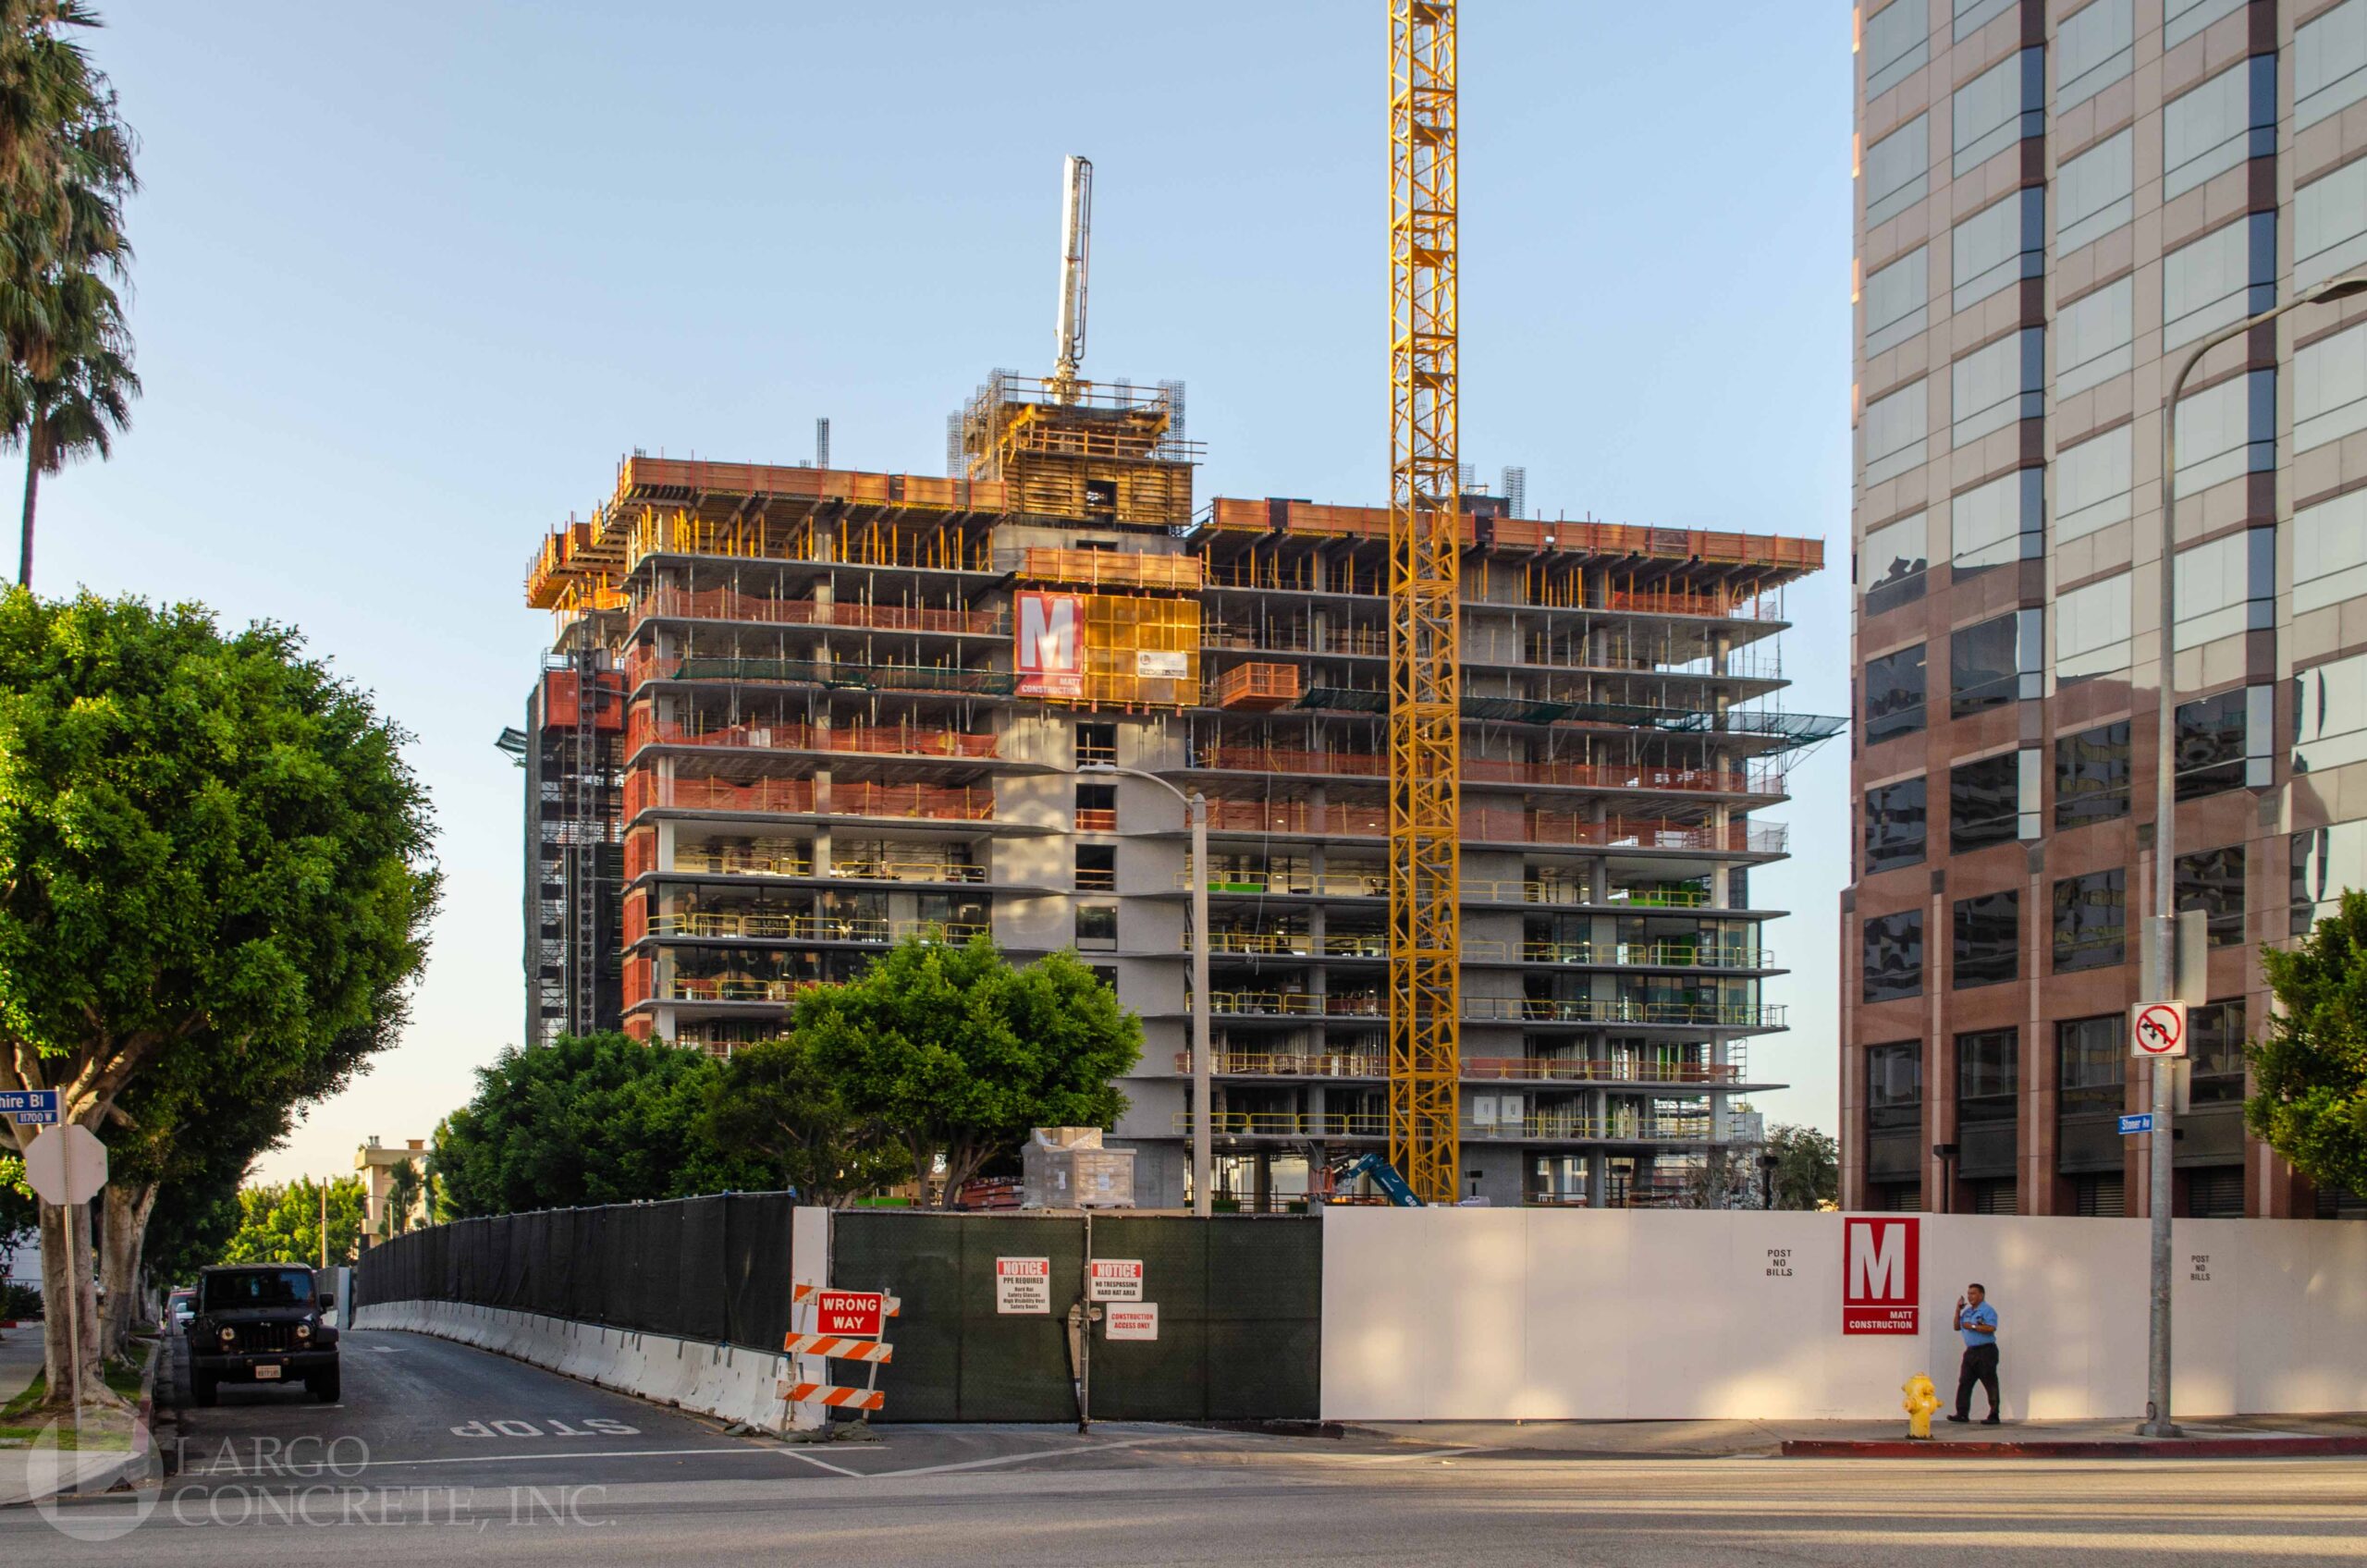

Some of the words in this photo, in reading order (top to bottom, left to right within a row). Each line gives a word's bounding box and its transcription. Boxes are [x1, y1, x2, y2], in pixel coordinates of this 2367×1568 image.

[1021, 596, 1073, 669] M
[1021, 684, 1081, 694] CONSTRUCTION
[31, 1094, 43, 1108] Bl
[44, 1112, 53, 1121] W
[1767, 1249, 1792, 1257] POST
[1772, 1258, 1785, 1267] NO
[1849, 1223, 1906, 1299] M
[1003, 1261, 1043, 1275] NOTICE
[1098, 1264, 1136, 1277] NOTICE
[1766, 1268, 1793, 1276] BILLS
[2190, 1272, 2210, 1280] BILLS
[823, 1298, 877, 1311] WRONG
[1890, 1311, 1913, 1319] MATT
[833, 1317, 865, 1329] WAY
[1849, 1320, 1913, 1329] CONSTRUCTION
[449, 1418, 641, 1437] STOP
